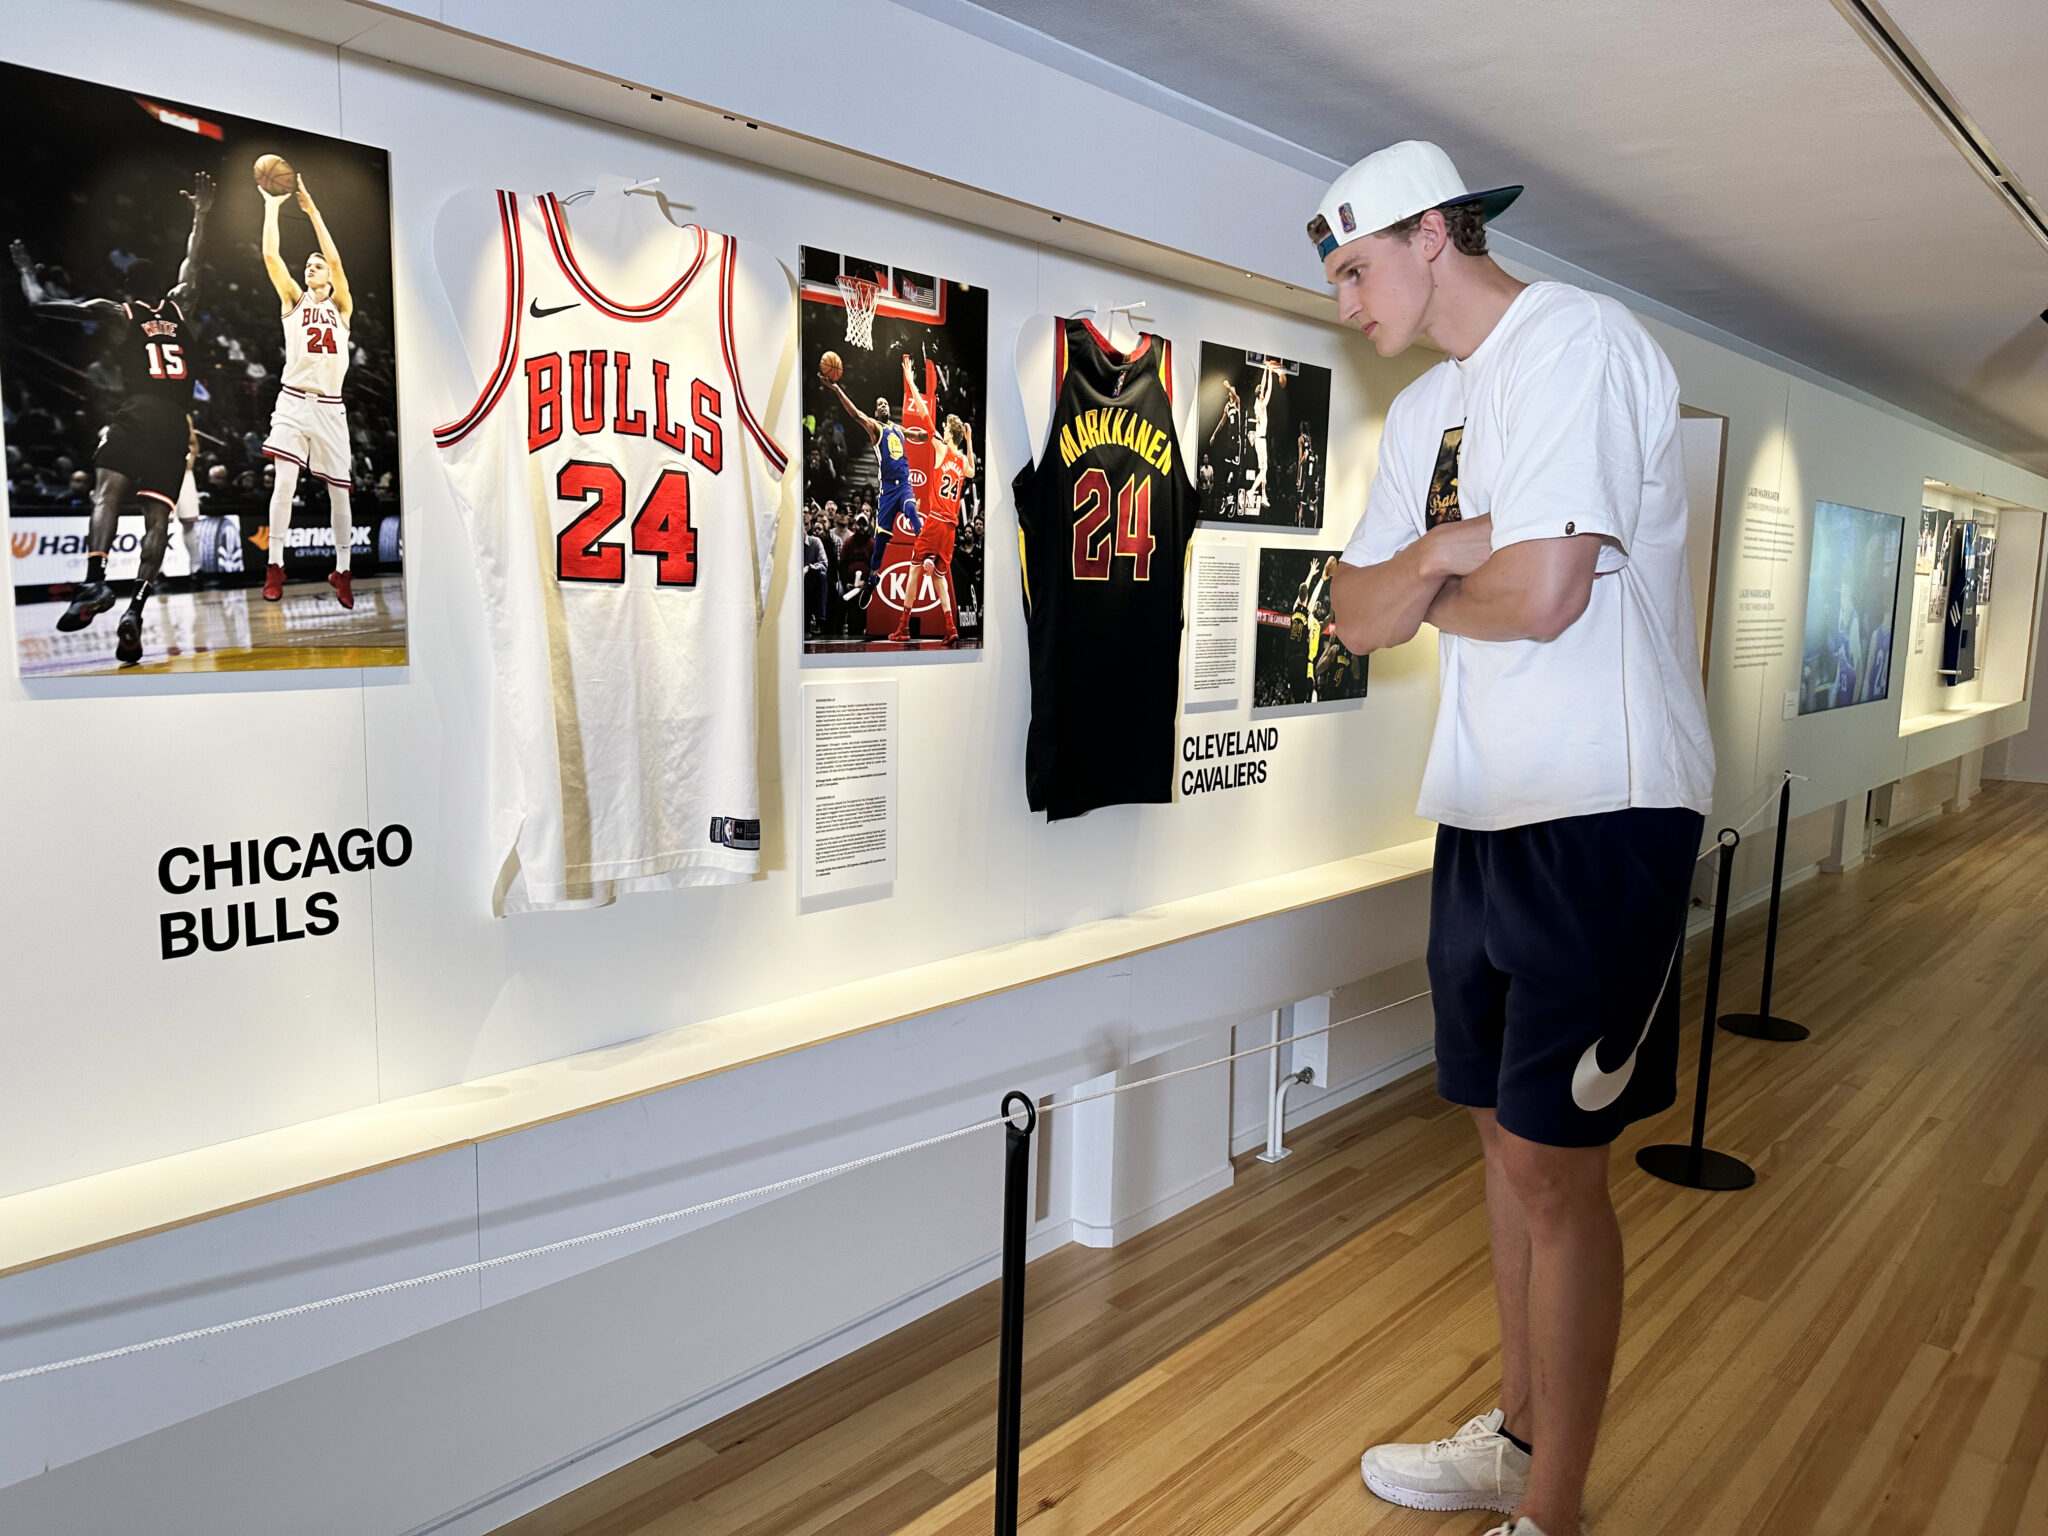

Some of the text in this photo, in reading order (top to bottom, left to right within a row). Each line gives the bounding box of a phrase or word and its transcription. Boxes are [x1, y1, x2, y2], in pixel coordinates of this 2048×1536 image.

[140, 320, 178, 338] WHITE
[302, 307, 338, 329] BULS
[306, 326, 338, 354] 24
[144, 342, 188, 380] 15
[523, 348, 723, 476] BULLS
[1059, 406, 1173, 477] MARKKANEN
[908, 472, 924, 483] KIA
[939, 474, 960, 502] 24
[284, 526, 372, 548] ankok
[556, 458, 699, 587] 24
[1071, 467, 1156, 581] 24
[889, 572, 938, 601] KA
[1182, 726, 1279, 763] CLEVELAND
[1181, 759, 1268, 797] CAVALIERS
[157, 823, 413, 895] CHICAGO
[159, 890, 340, 960] BULLS
